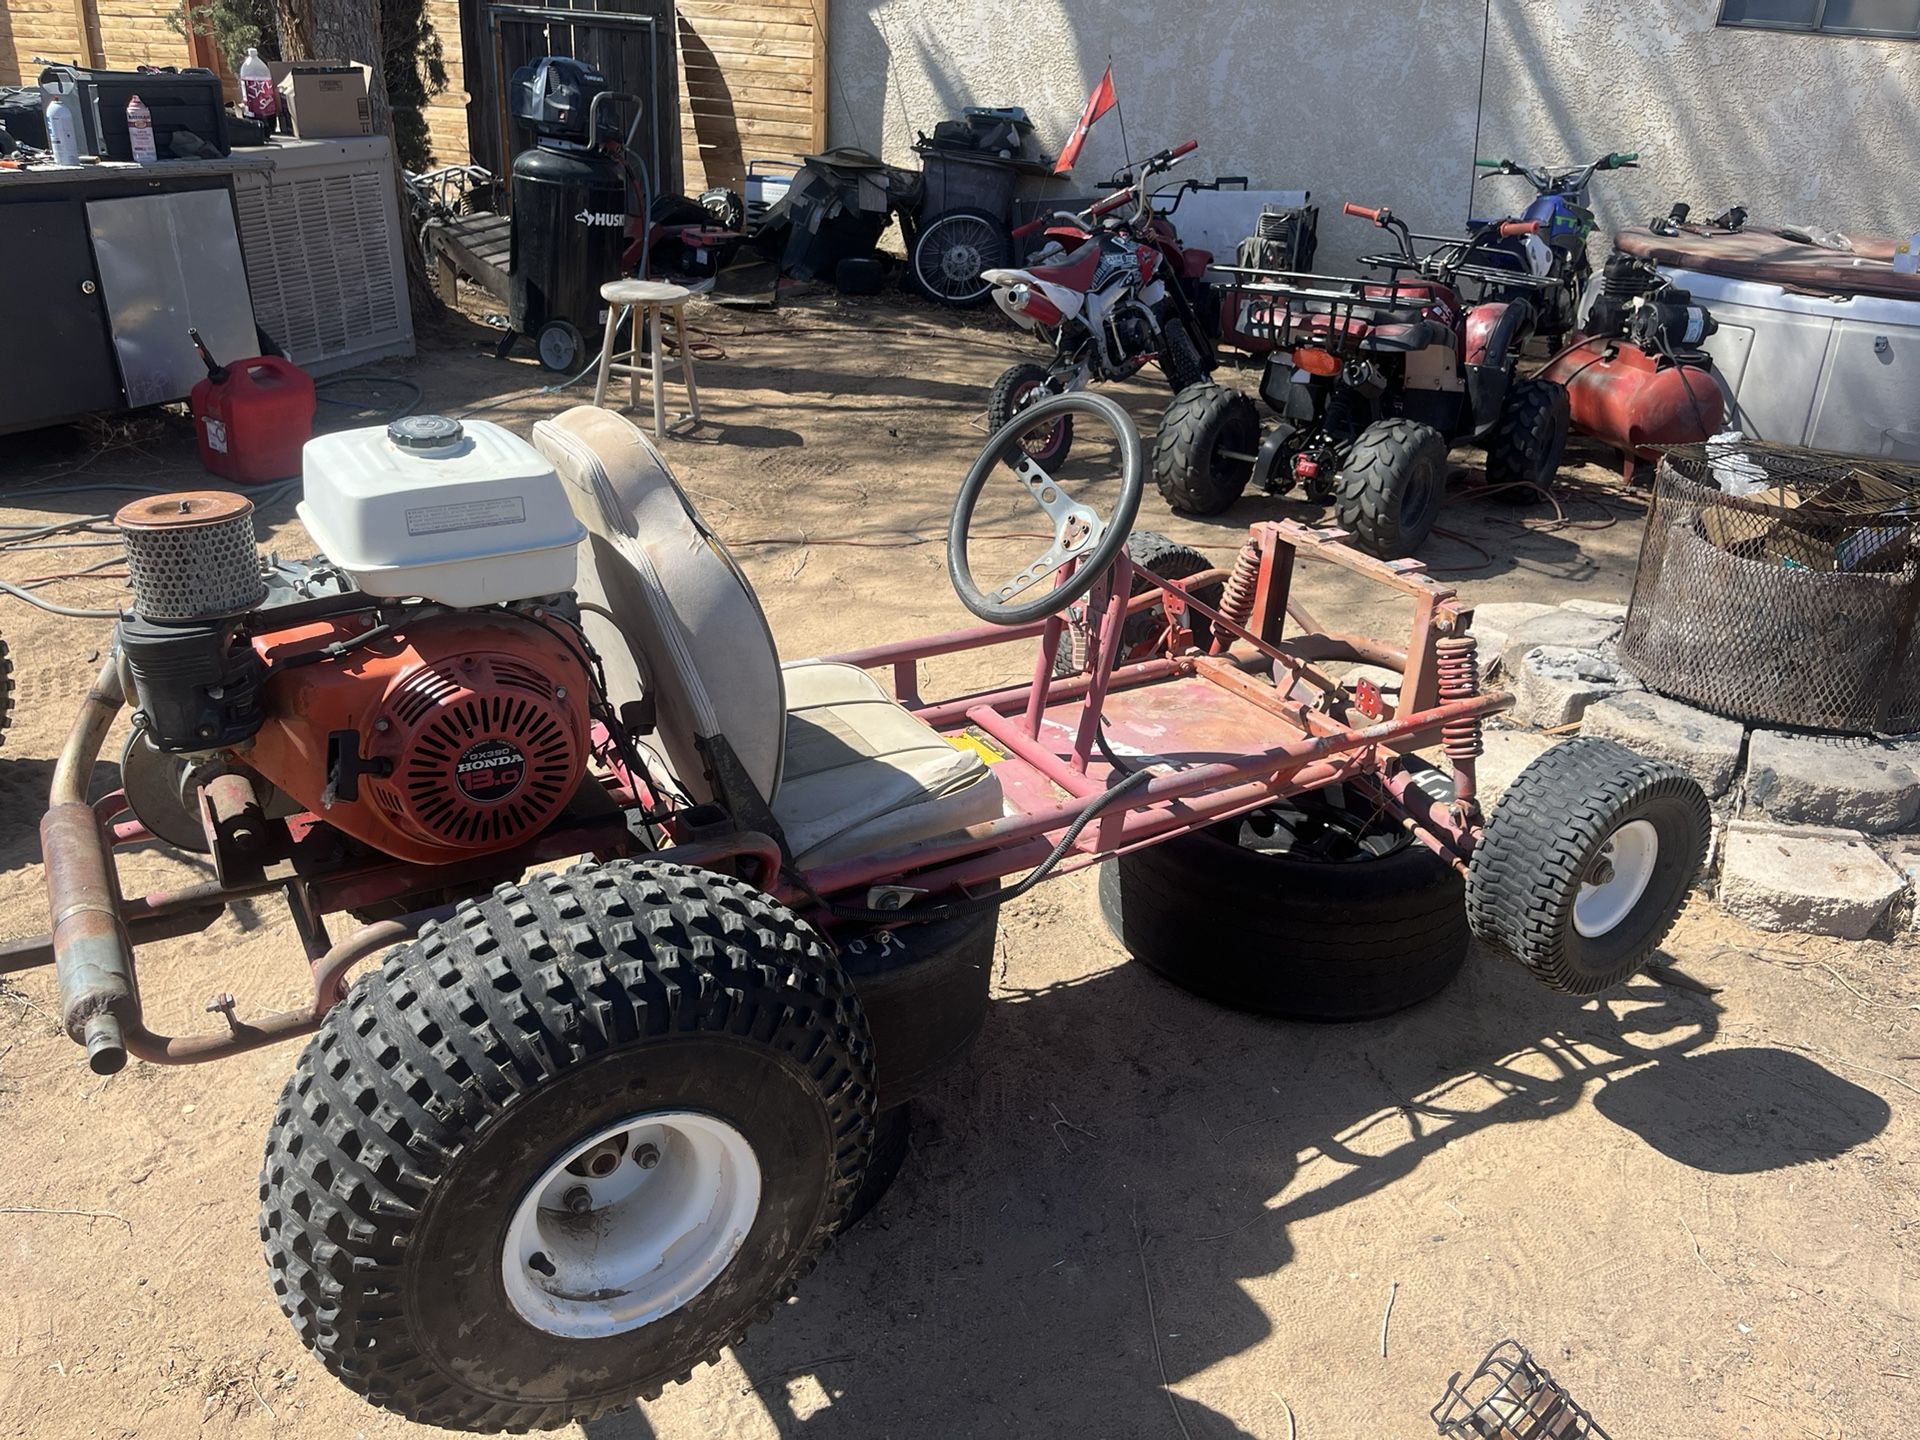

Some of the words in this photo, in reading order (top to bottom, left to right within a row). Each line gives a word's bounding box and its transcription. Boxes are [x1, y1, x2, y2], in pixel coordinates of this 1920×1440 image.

[595, 213, 625, 226] HUSK
[469, 748, 510, 761] GX390
[458, 753, 525, 773] HONDA
[460, 768, 520, 791] 13.0
